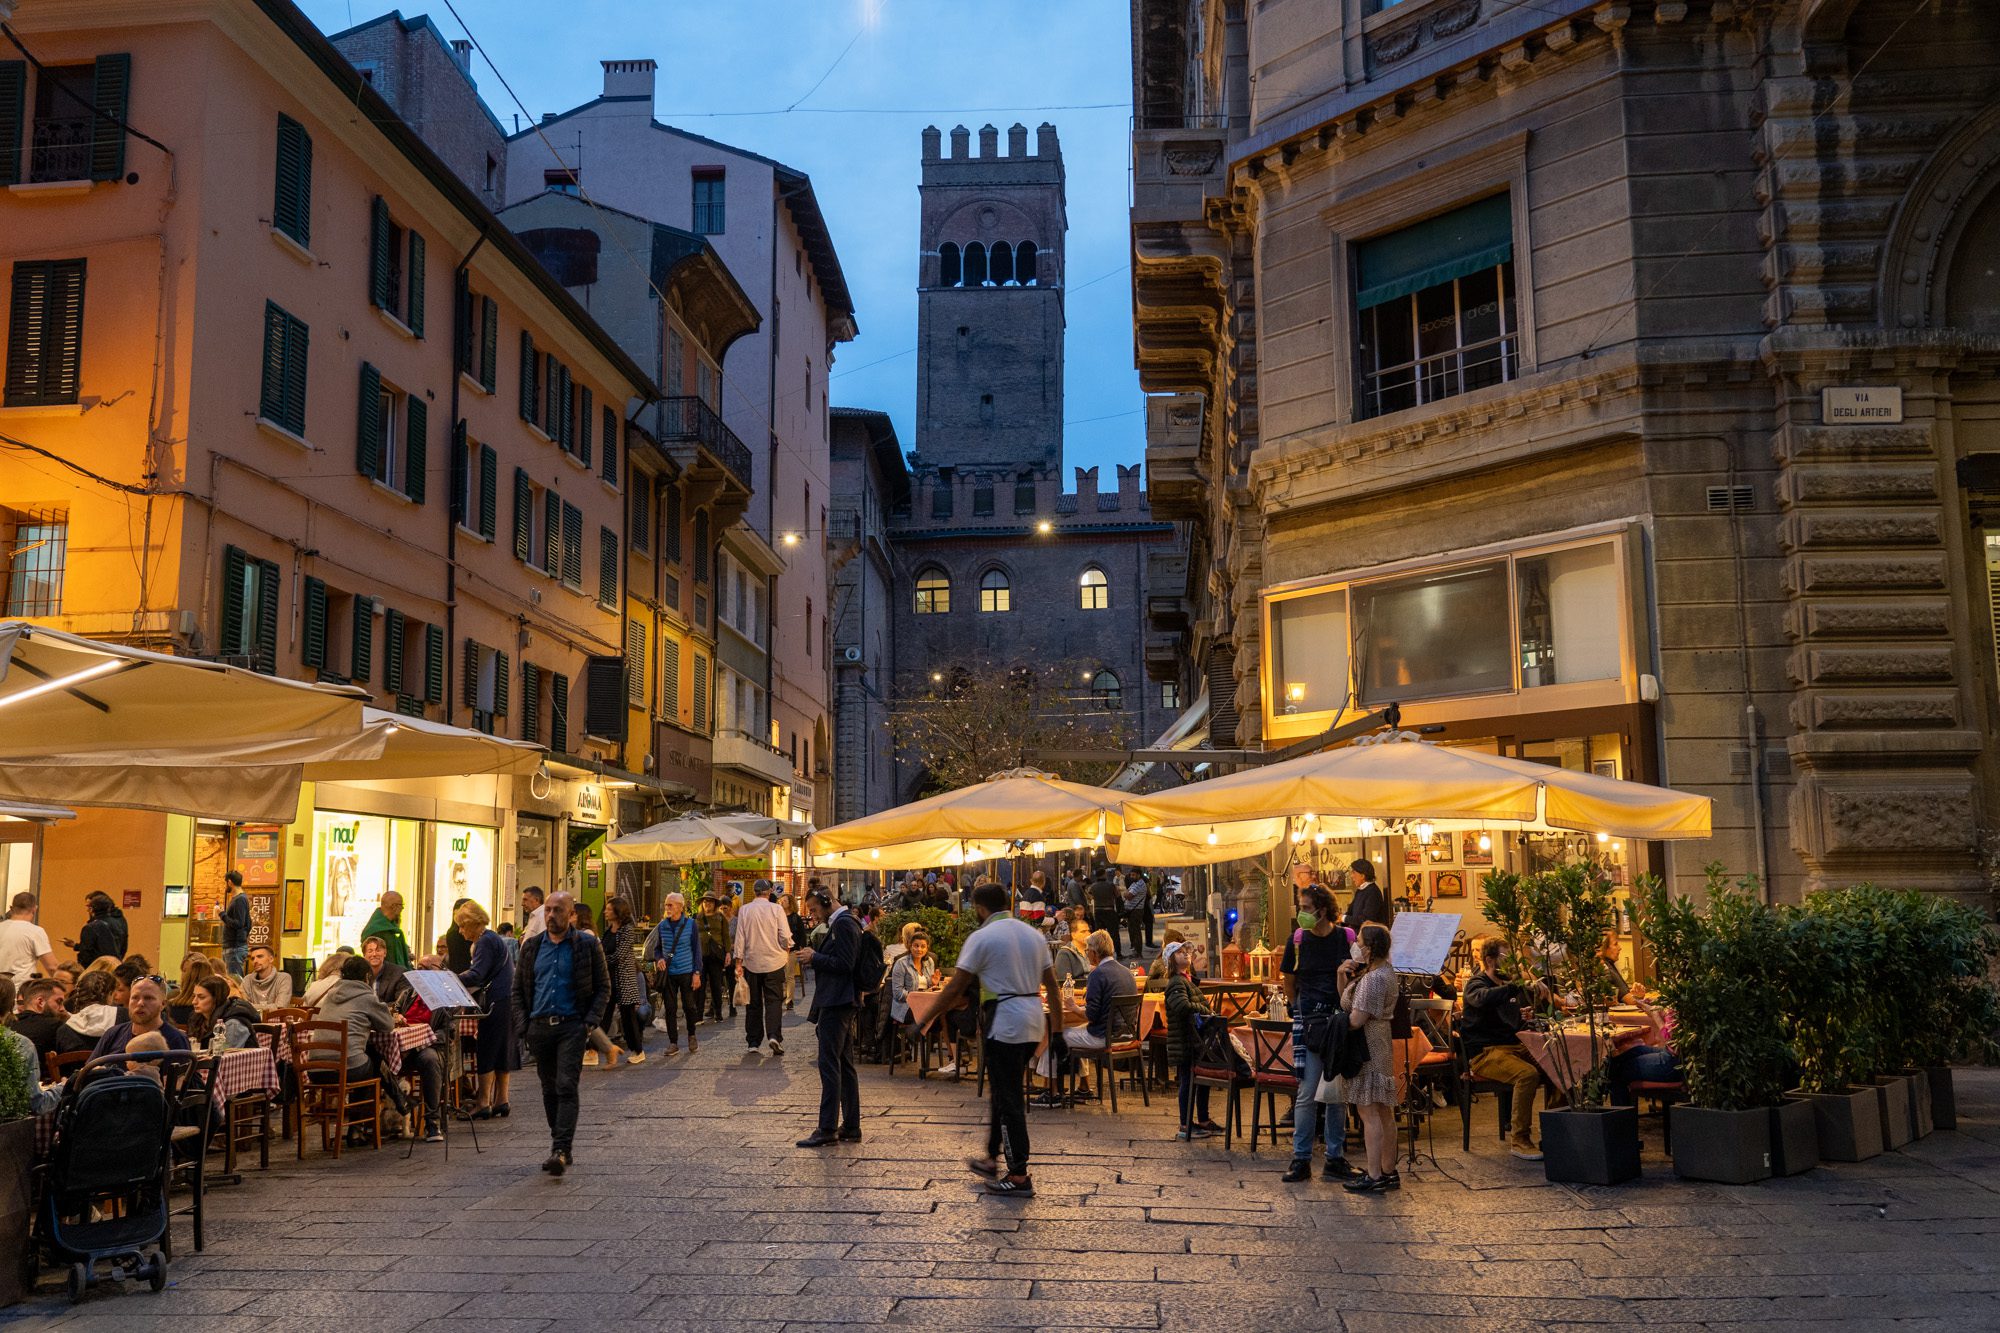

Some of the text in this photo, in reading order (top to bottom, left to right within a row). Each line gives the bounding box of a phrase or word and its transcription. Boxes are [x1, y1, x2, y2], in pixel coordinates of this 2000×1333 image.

[1854, 393, 1869, 402] VIA
[1833, 407, 1892, 417] DEGLI ARTIERI
[577, 791, 602, 811] AROMA
[260, 896, 271, 906] TU
[252, 905, 270, 914] CHE
[249, 926, 270, 935] STO
[249, 934, 269, 944] SEI?
